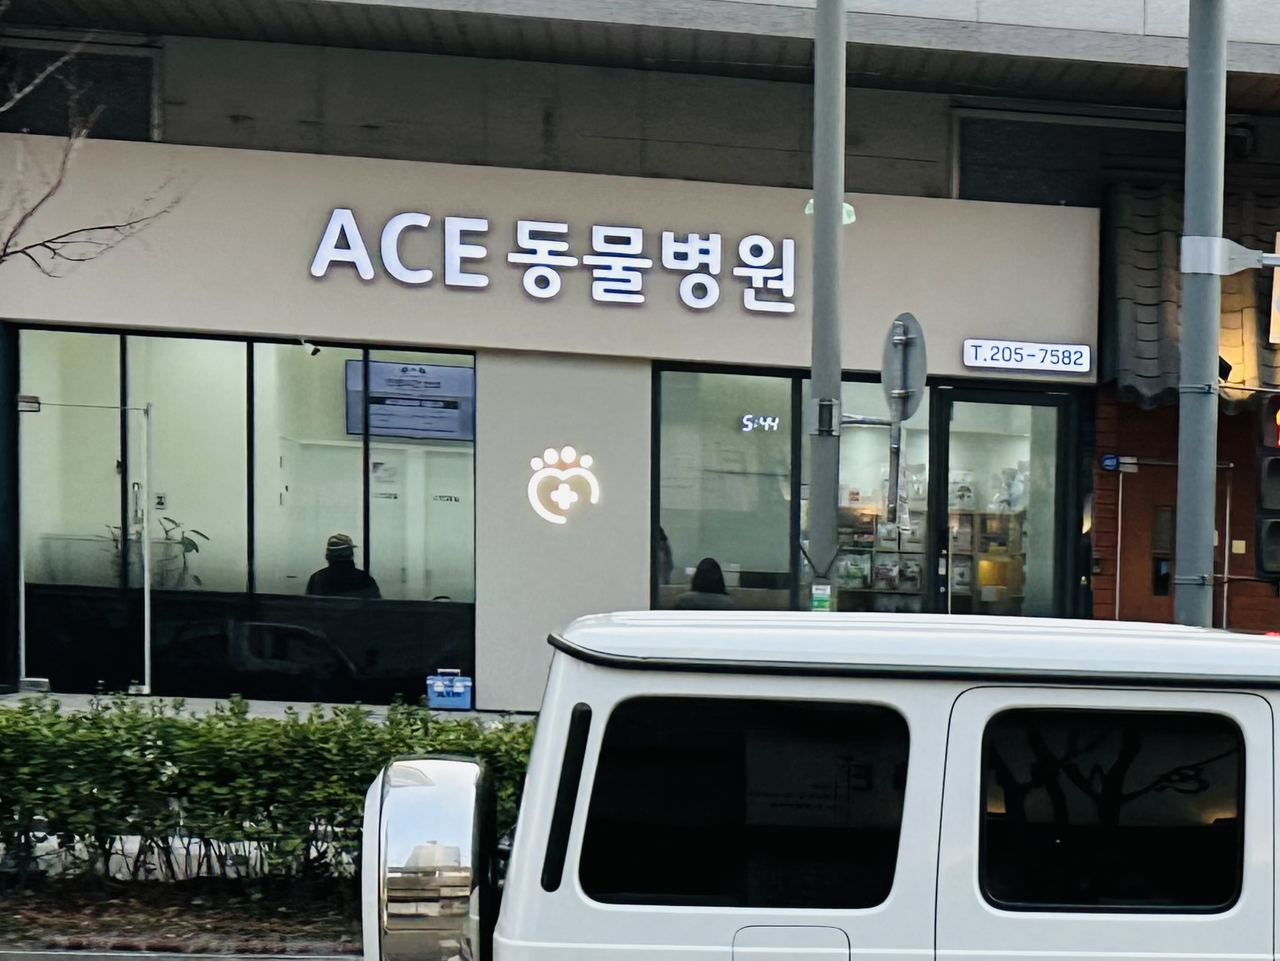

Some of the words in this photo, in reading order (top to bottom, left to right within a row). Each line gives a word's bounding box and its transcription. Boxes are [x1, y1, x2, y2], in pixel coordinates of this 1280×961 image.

[310, 207, 490, 288] ACE
[507, 219, 797, 314] 동물병원
[970, 344, 1084, 366] T.205-7582
[742, 414, 780, 431] 5:44
